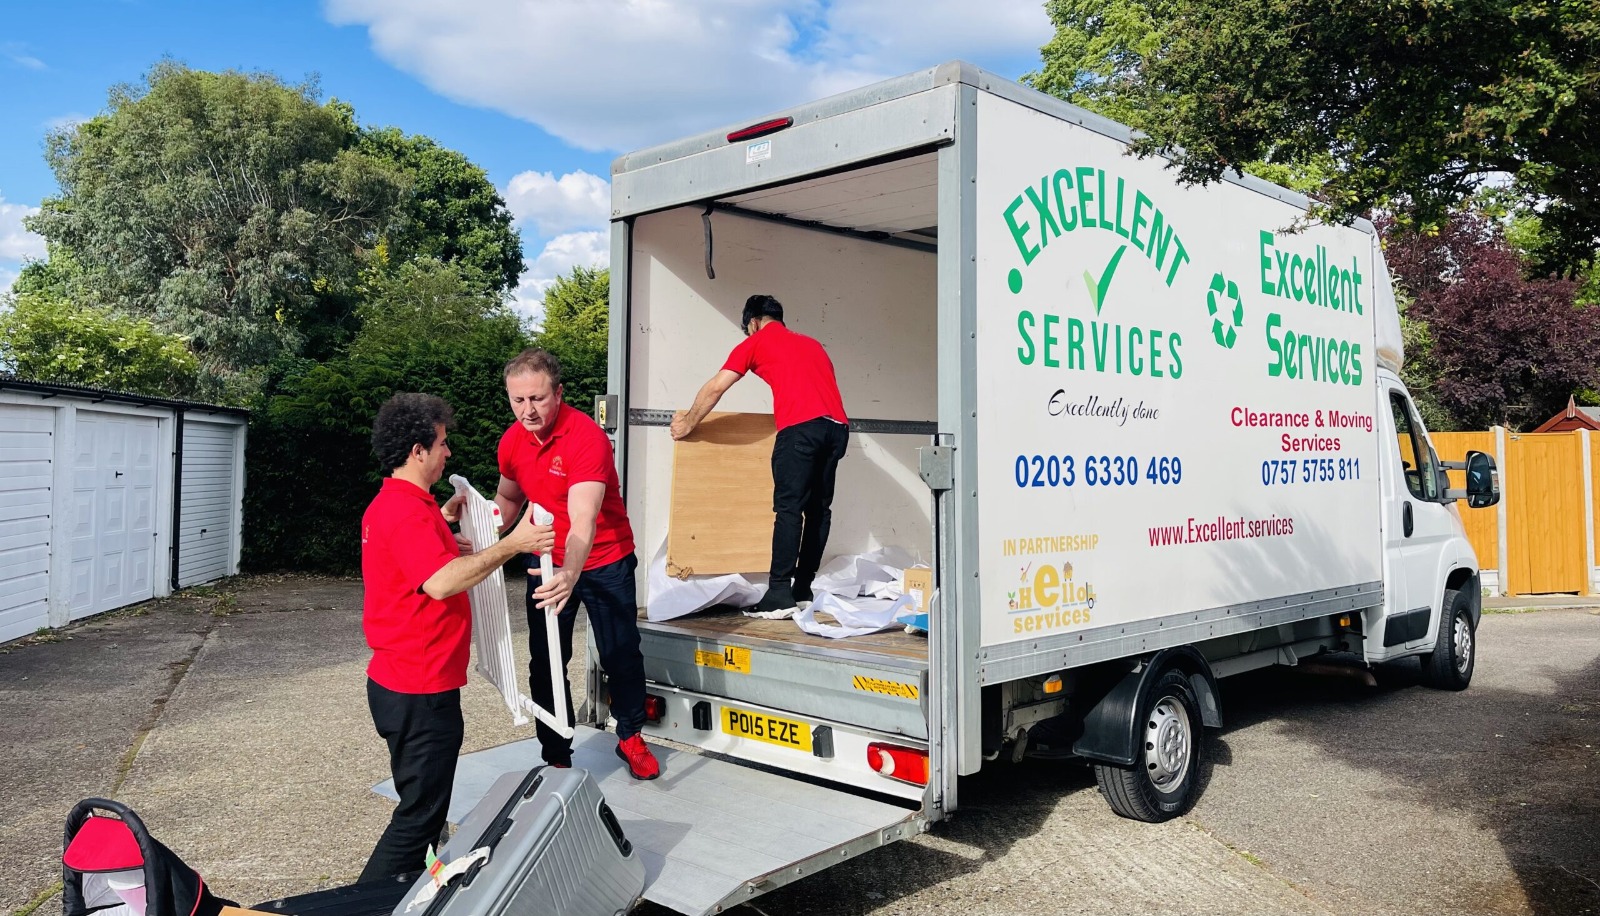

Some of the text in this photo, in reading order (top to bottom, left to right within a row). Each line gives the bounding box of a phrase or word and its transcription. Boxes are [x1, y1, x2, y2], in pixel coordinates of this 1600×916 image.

[1003, 166, 1190, 288] EXCELLENT
[1260, 229, 1363, 315] Excellent
[1017, 310, 1183, 380] SERVICES
[1265, 312, 1363, 386] Services
[1047, 388, 1160, 427] Excellently done
[1231, 406, 1373, 433] Clearance & Moving
[1281, 433, 1341, 452] Services
[1015, 454, 1182, 488] 0203 6330 469
[1261, 457, 1361, 486] 0757 5755 811
[1003, 533, 1099, 557] IN PARTNERSHIP
[1148, 514, 1294, 547] www.Excellent.services
[1018, 564, 1087, 609] Hello
[1013, 606, 1091, 634] services
[729, 710, 800, 745] PO15 EZE
